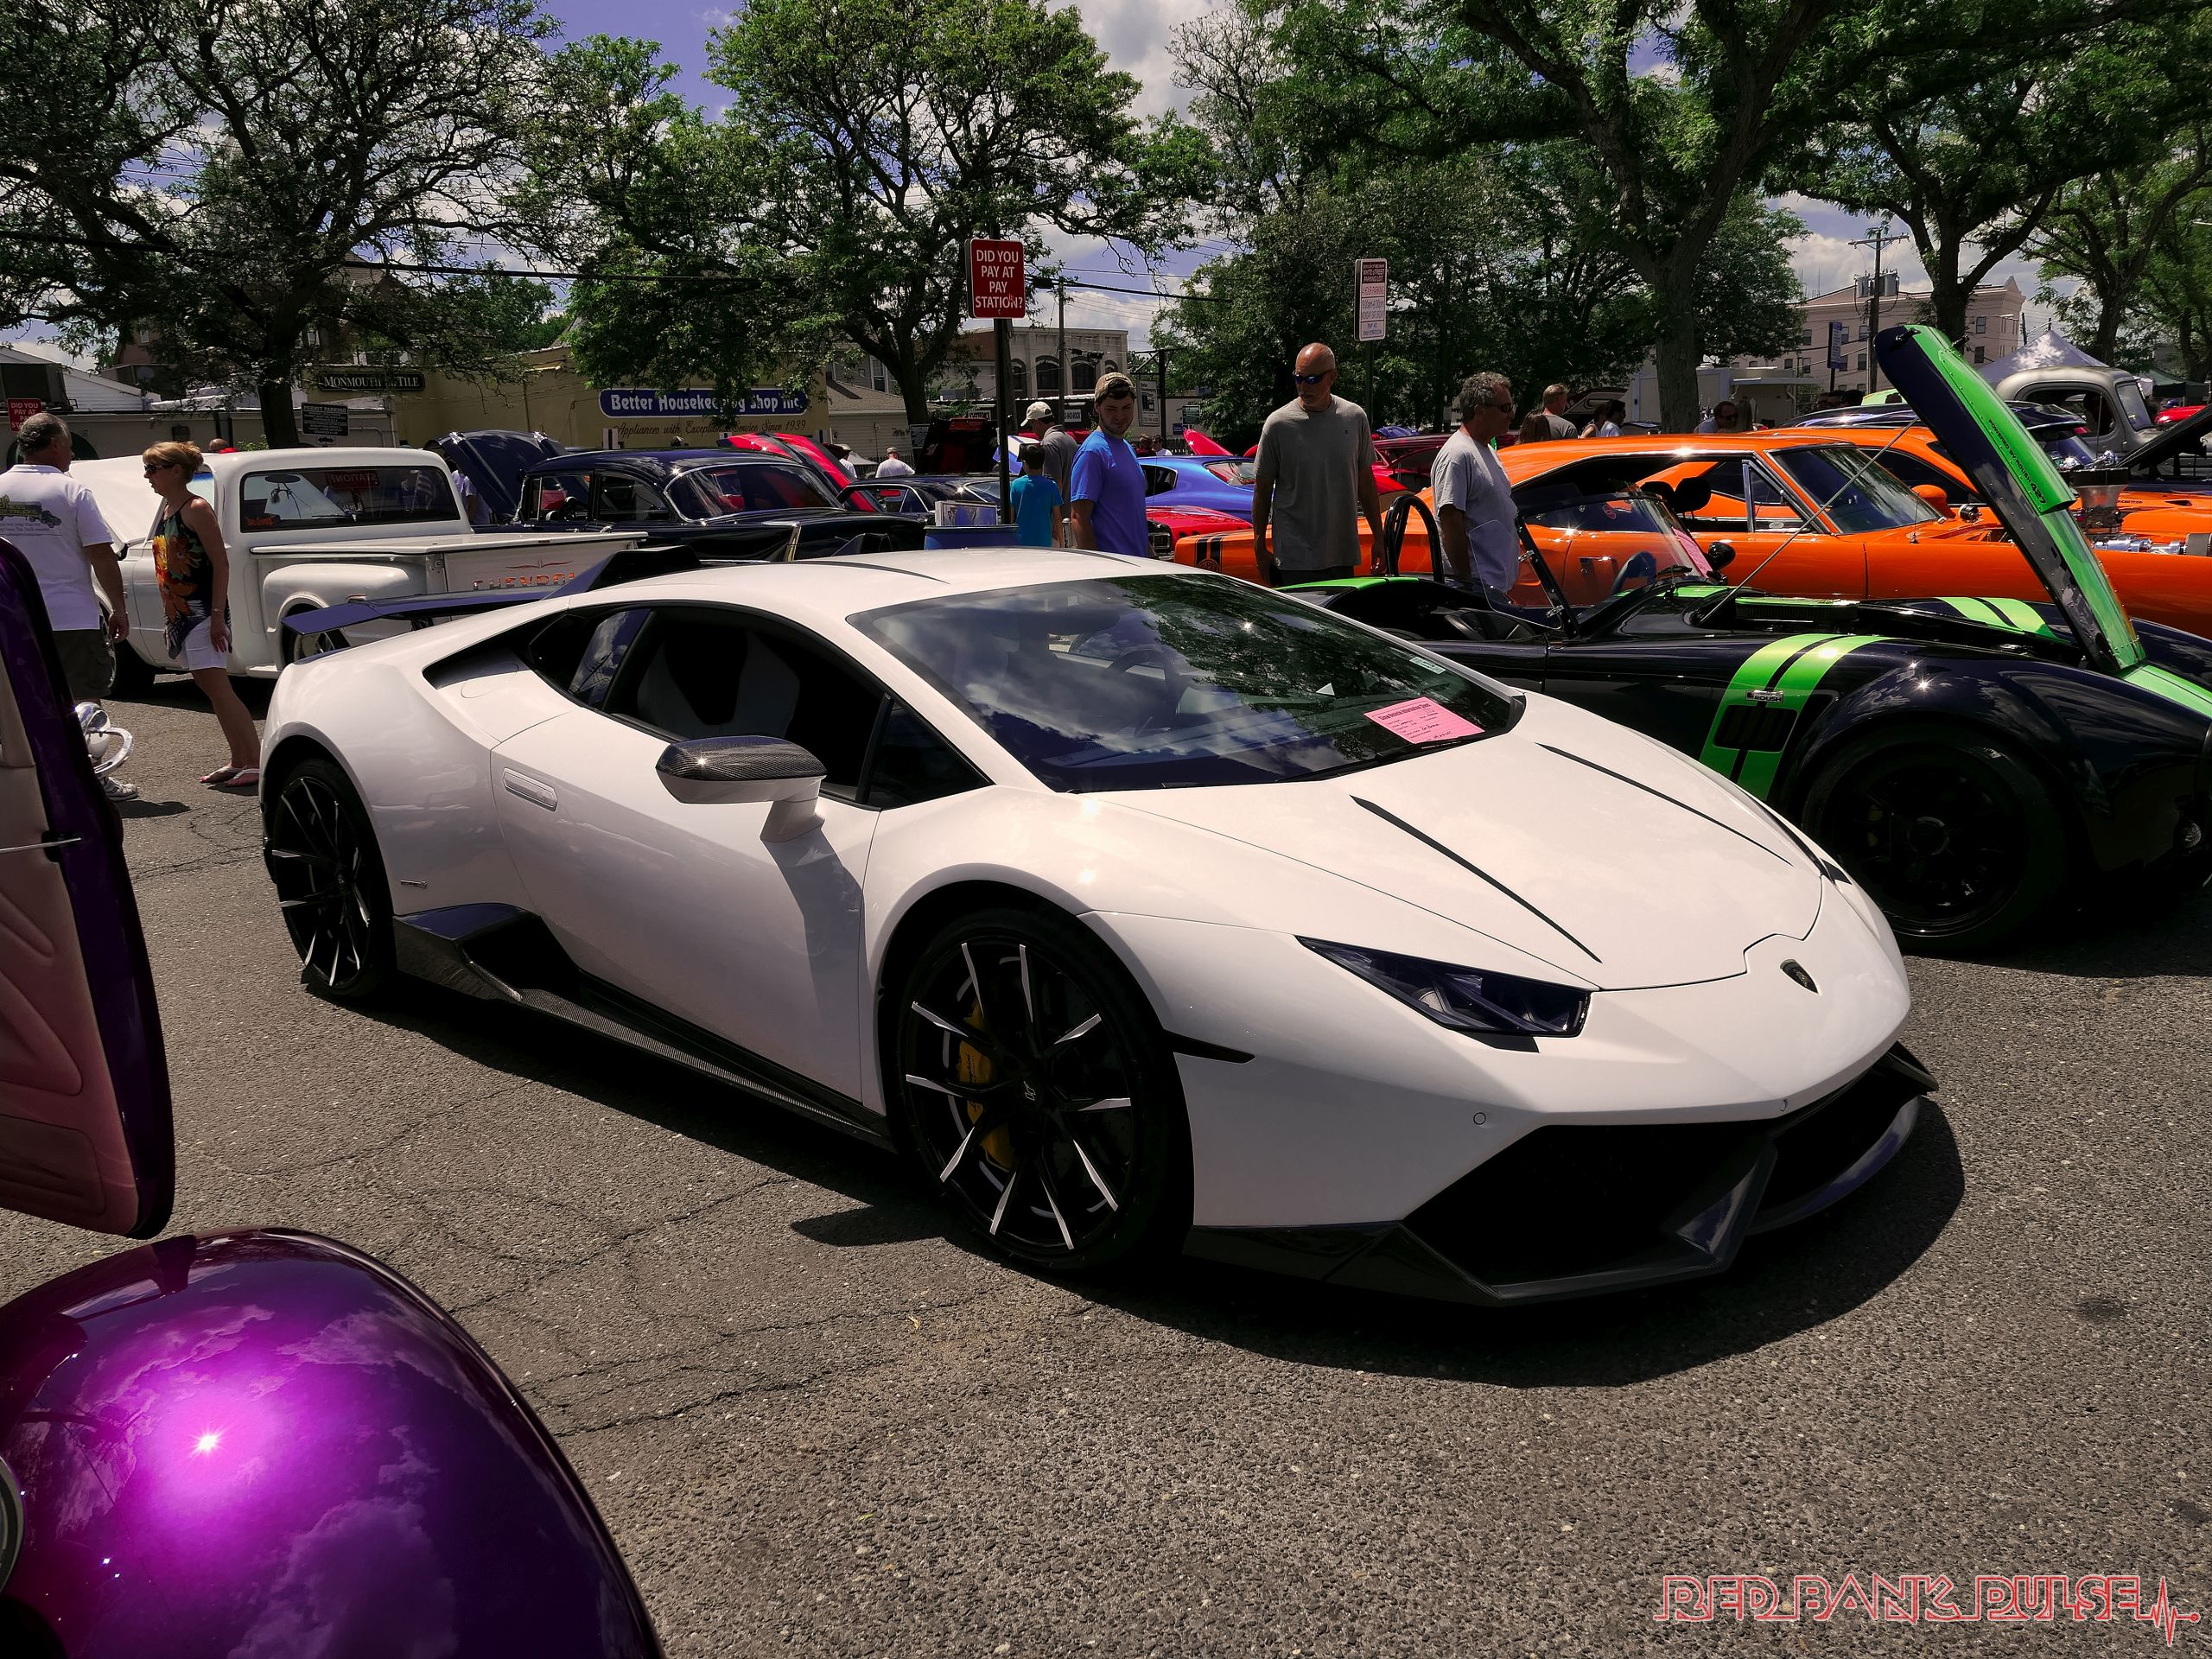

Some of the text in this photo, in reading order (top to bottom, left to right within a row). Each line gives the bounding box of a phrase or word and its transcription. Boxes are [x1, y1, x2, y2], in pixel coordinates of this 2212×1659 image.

[976, 250, 1019, 263] DID YOU
[982, 265, 1015, 278] PAY AT
[989, 281, 1007, 293] PAY
[975, 296, 1023, 308] STATION?
[397, 376, 420, 387] TILE
[611, 394, 653, 410] Better
[750, 394, 779, 412] Shop
[614, 422, 659, 436] Appliances
[664, 423, 680, 434] with
[761, 419, 783, 432] Since
[784, 419, 807, 431] 1939
[1989, 419, 2046, 503] POWERED BY ROUSH 427
